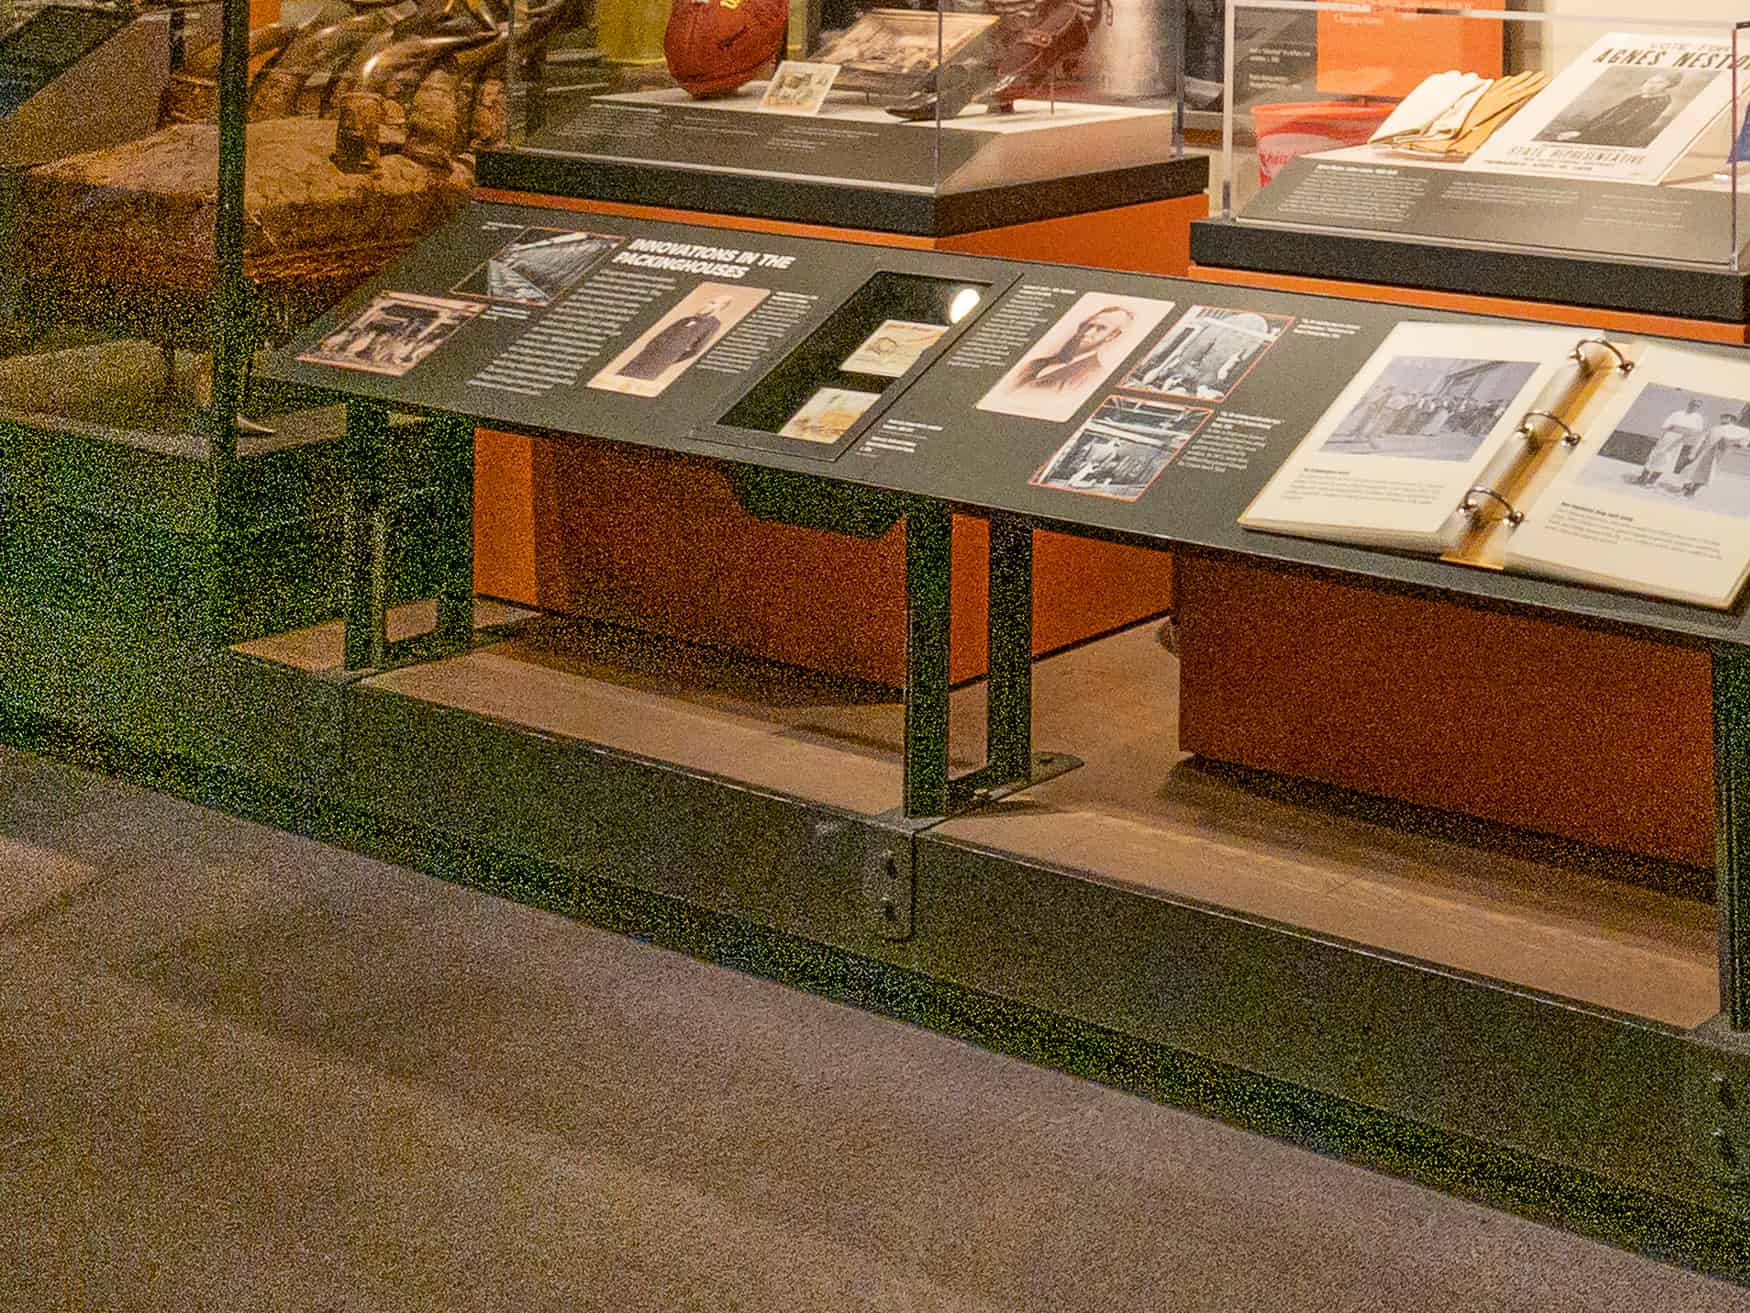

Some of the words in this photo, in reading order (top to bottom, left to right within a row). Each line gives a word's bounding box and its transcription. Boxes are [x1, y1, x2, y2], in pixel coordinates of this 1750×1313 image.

[1593, 48, 1667, 65] AGNES
[612, 251, 749, 279] PACKINGHOUSES
[627, 239, 739, 262] INNOVATIONS
[736, 250, 756, 265] IN
[757, 254, 796, 269] THE
